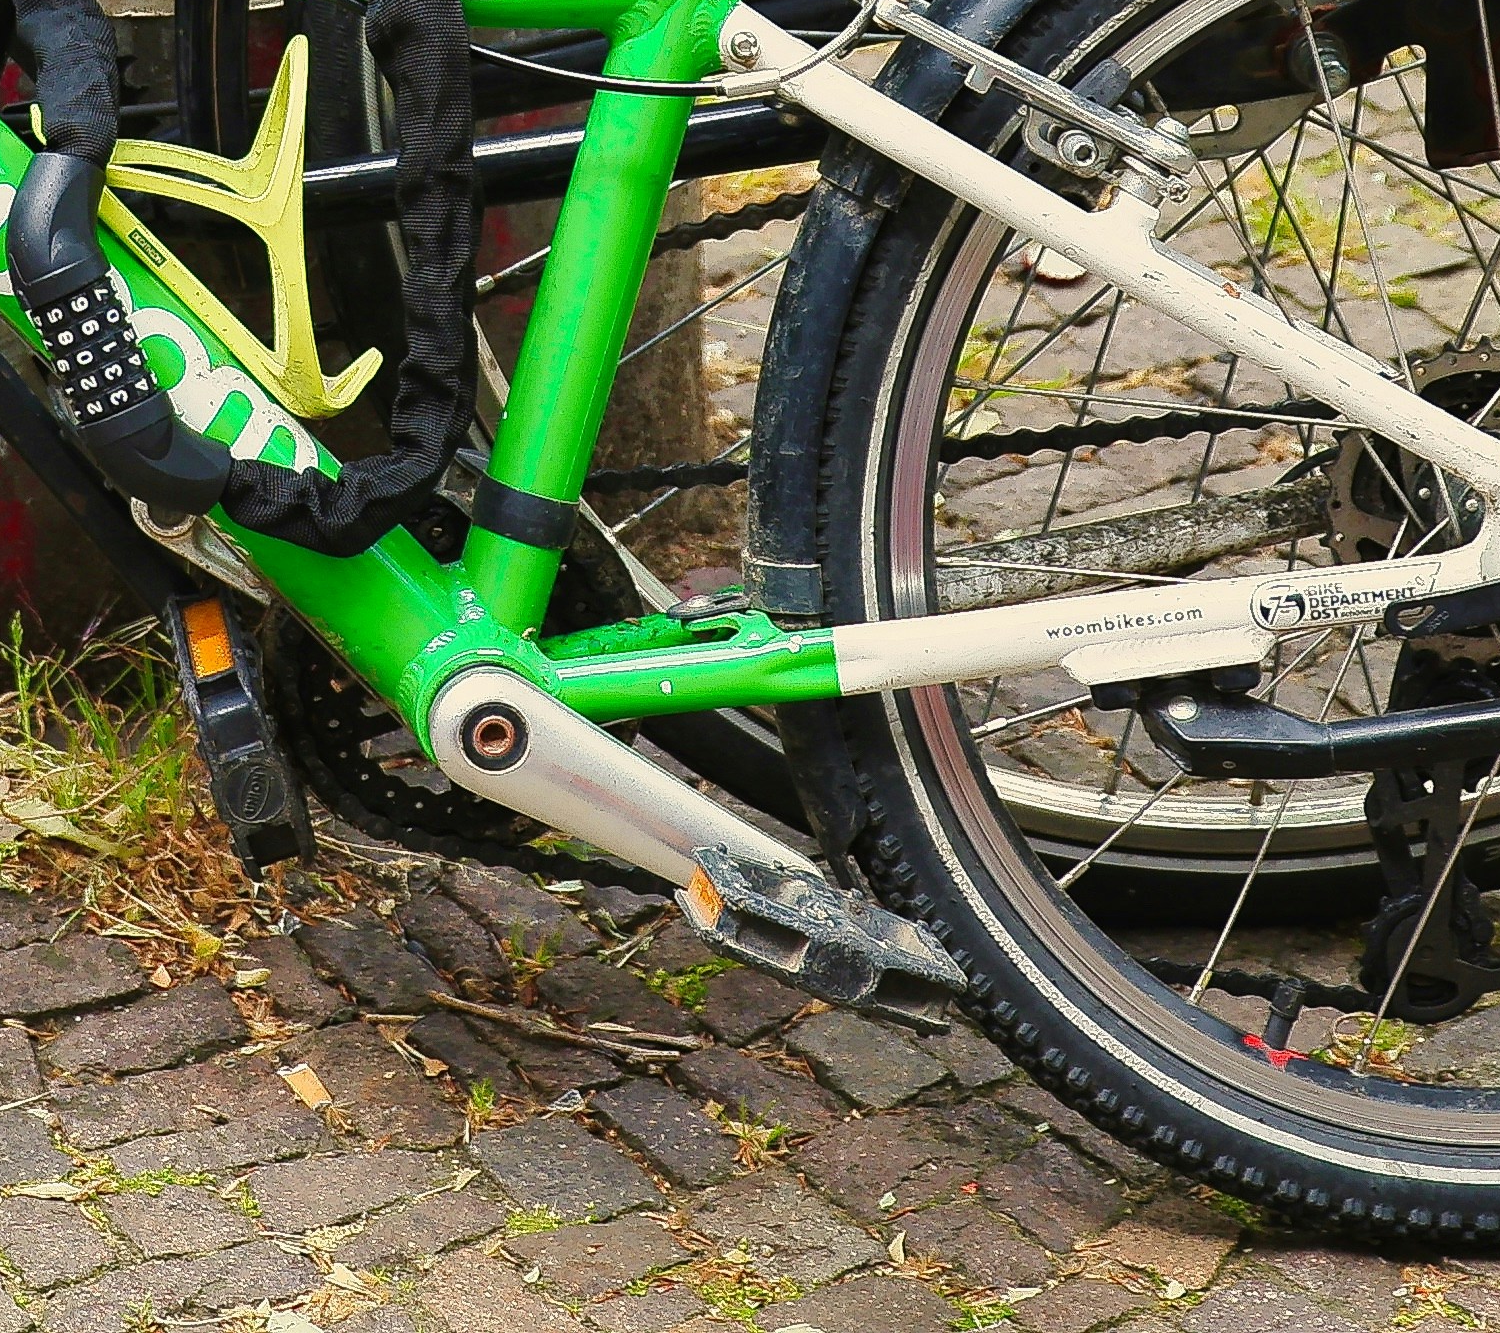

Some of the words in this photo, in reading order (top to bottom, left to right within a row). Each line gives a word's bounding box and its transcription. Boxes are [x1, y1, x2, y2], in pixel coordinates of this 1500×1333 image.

[1309, 586, 1416, 609] DEPARTMENT
[1046, 606, 1204, 640] woombikes.com
[1310, 607, 1341, 621] OST
